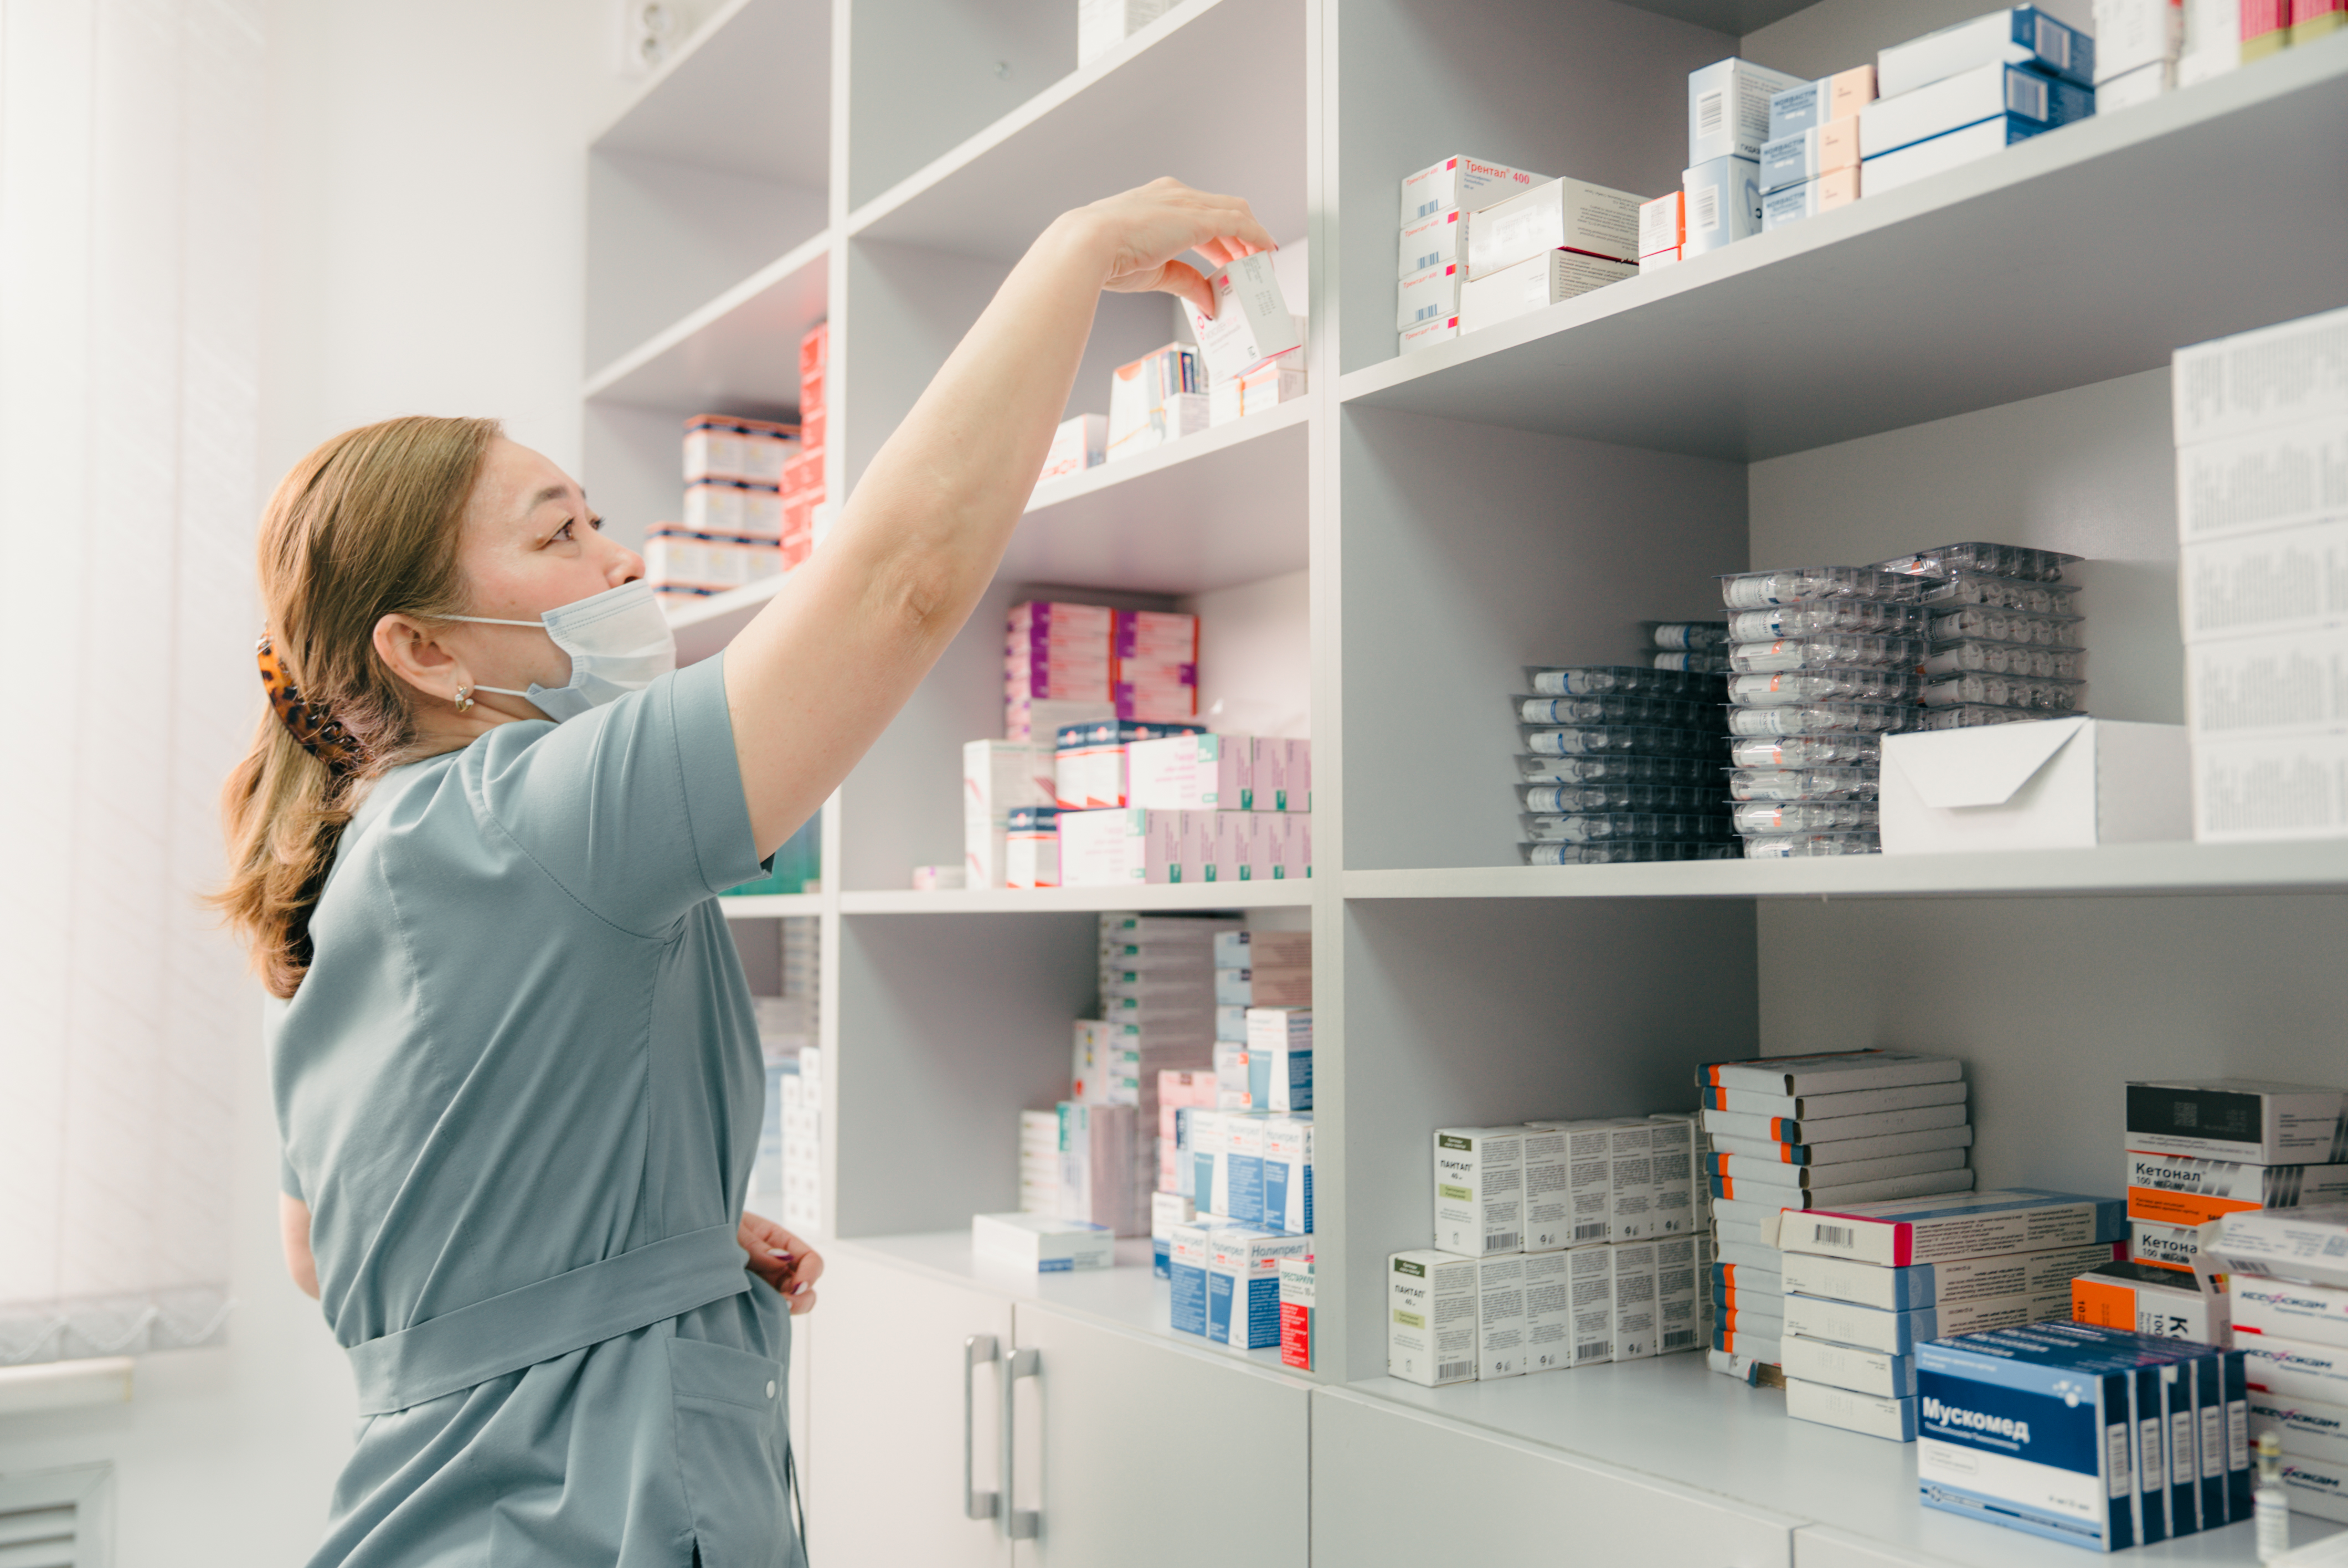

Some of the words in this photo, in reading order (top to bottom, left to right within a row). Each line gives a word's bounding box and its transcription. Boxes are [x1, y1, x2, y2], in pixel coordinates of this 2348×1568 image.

[1774, 89, 1817, 107] NORBACTIN
[1513, 172, 1530, 185] 400
[2136, 1162, 2200, 1182] Кетонал
[2136, 1176, 2151, 1185] 100
[2143, 1234, 2197, 1254] Кетона
[2143, 1248, 2158, 1257] 100
[1922, 1396, 2031, 1445] Мускомед
